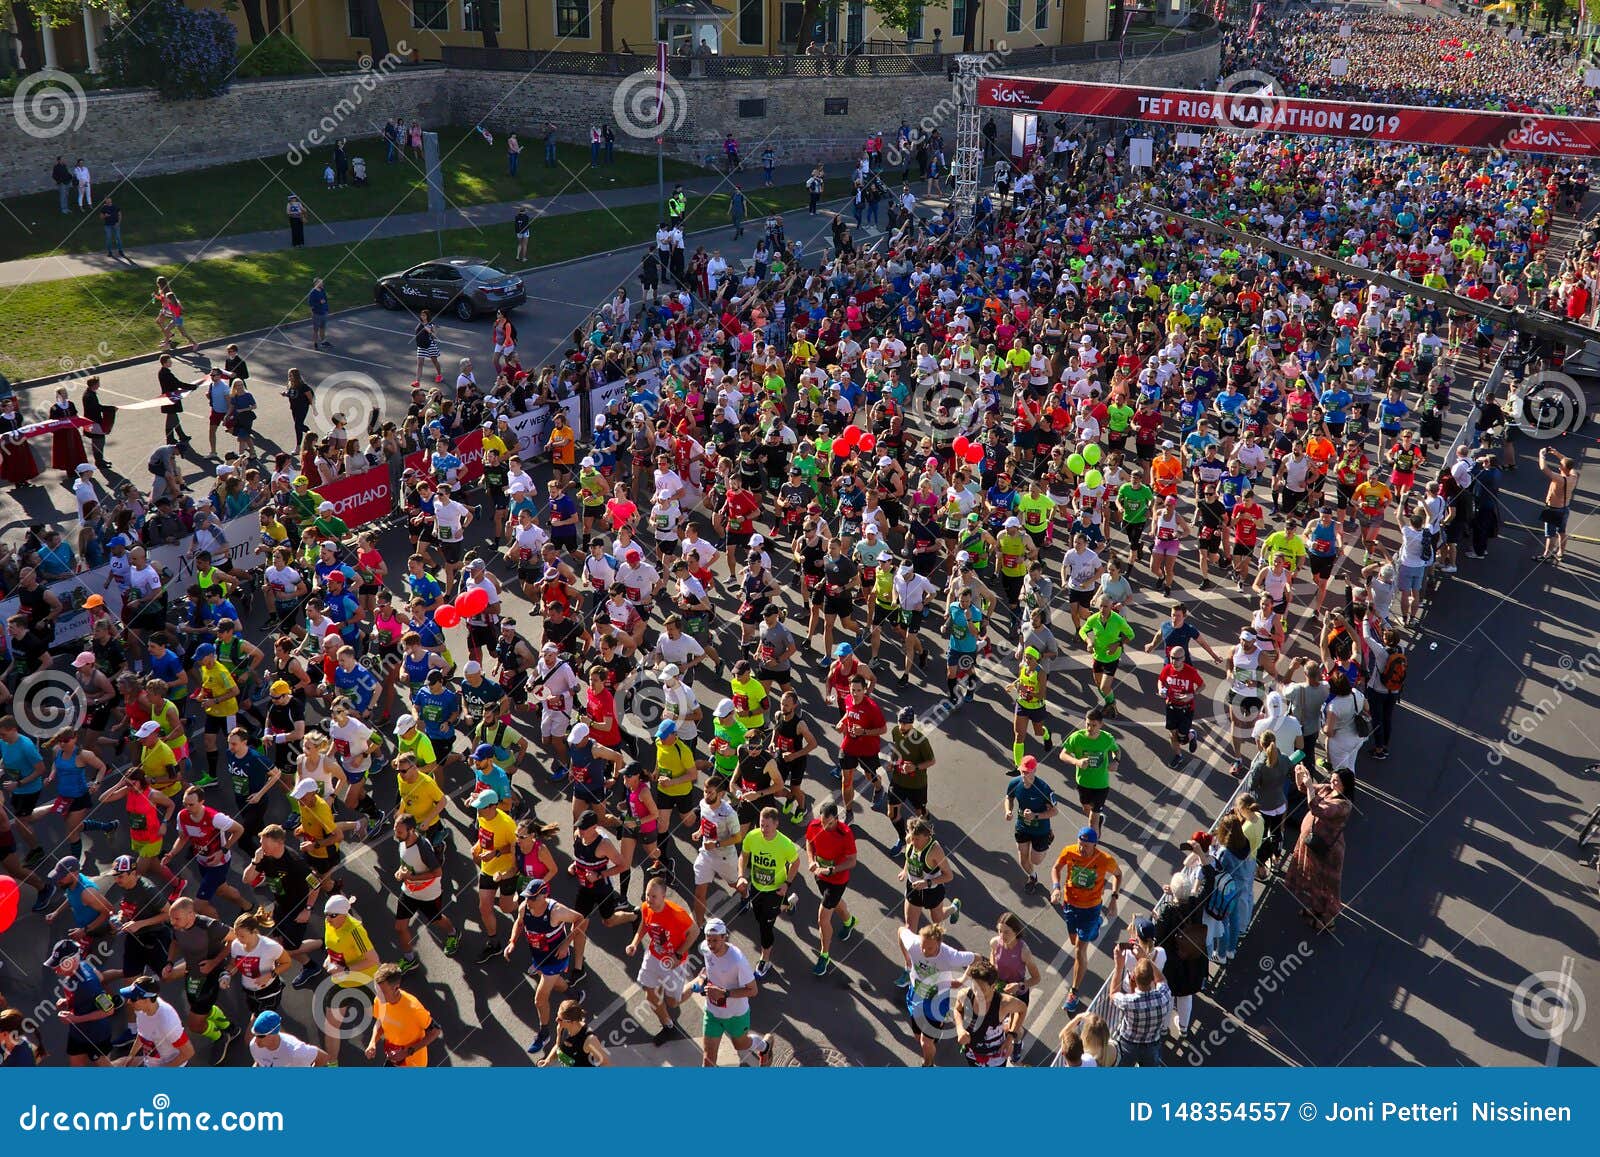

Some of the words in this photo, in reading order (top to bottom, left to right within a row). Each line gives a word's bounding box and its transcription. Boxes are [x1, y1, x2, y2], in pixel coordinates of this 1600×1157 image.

[1138, 97, 1172, 114] TET
[1178, 100, 1223, 120] RIGA
[1230, 105, 1343, 129] MARATHON
[1350, 113, 1400, 134] 2019
[753, 855, 777, 867] RIGA
